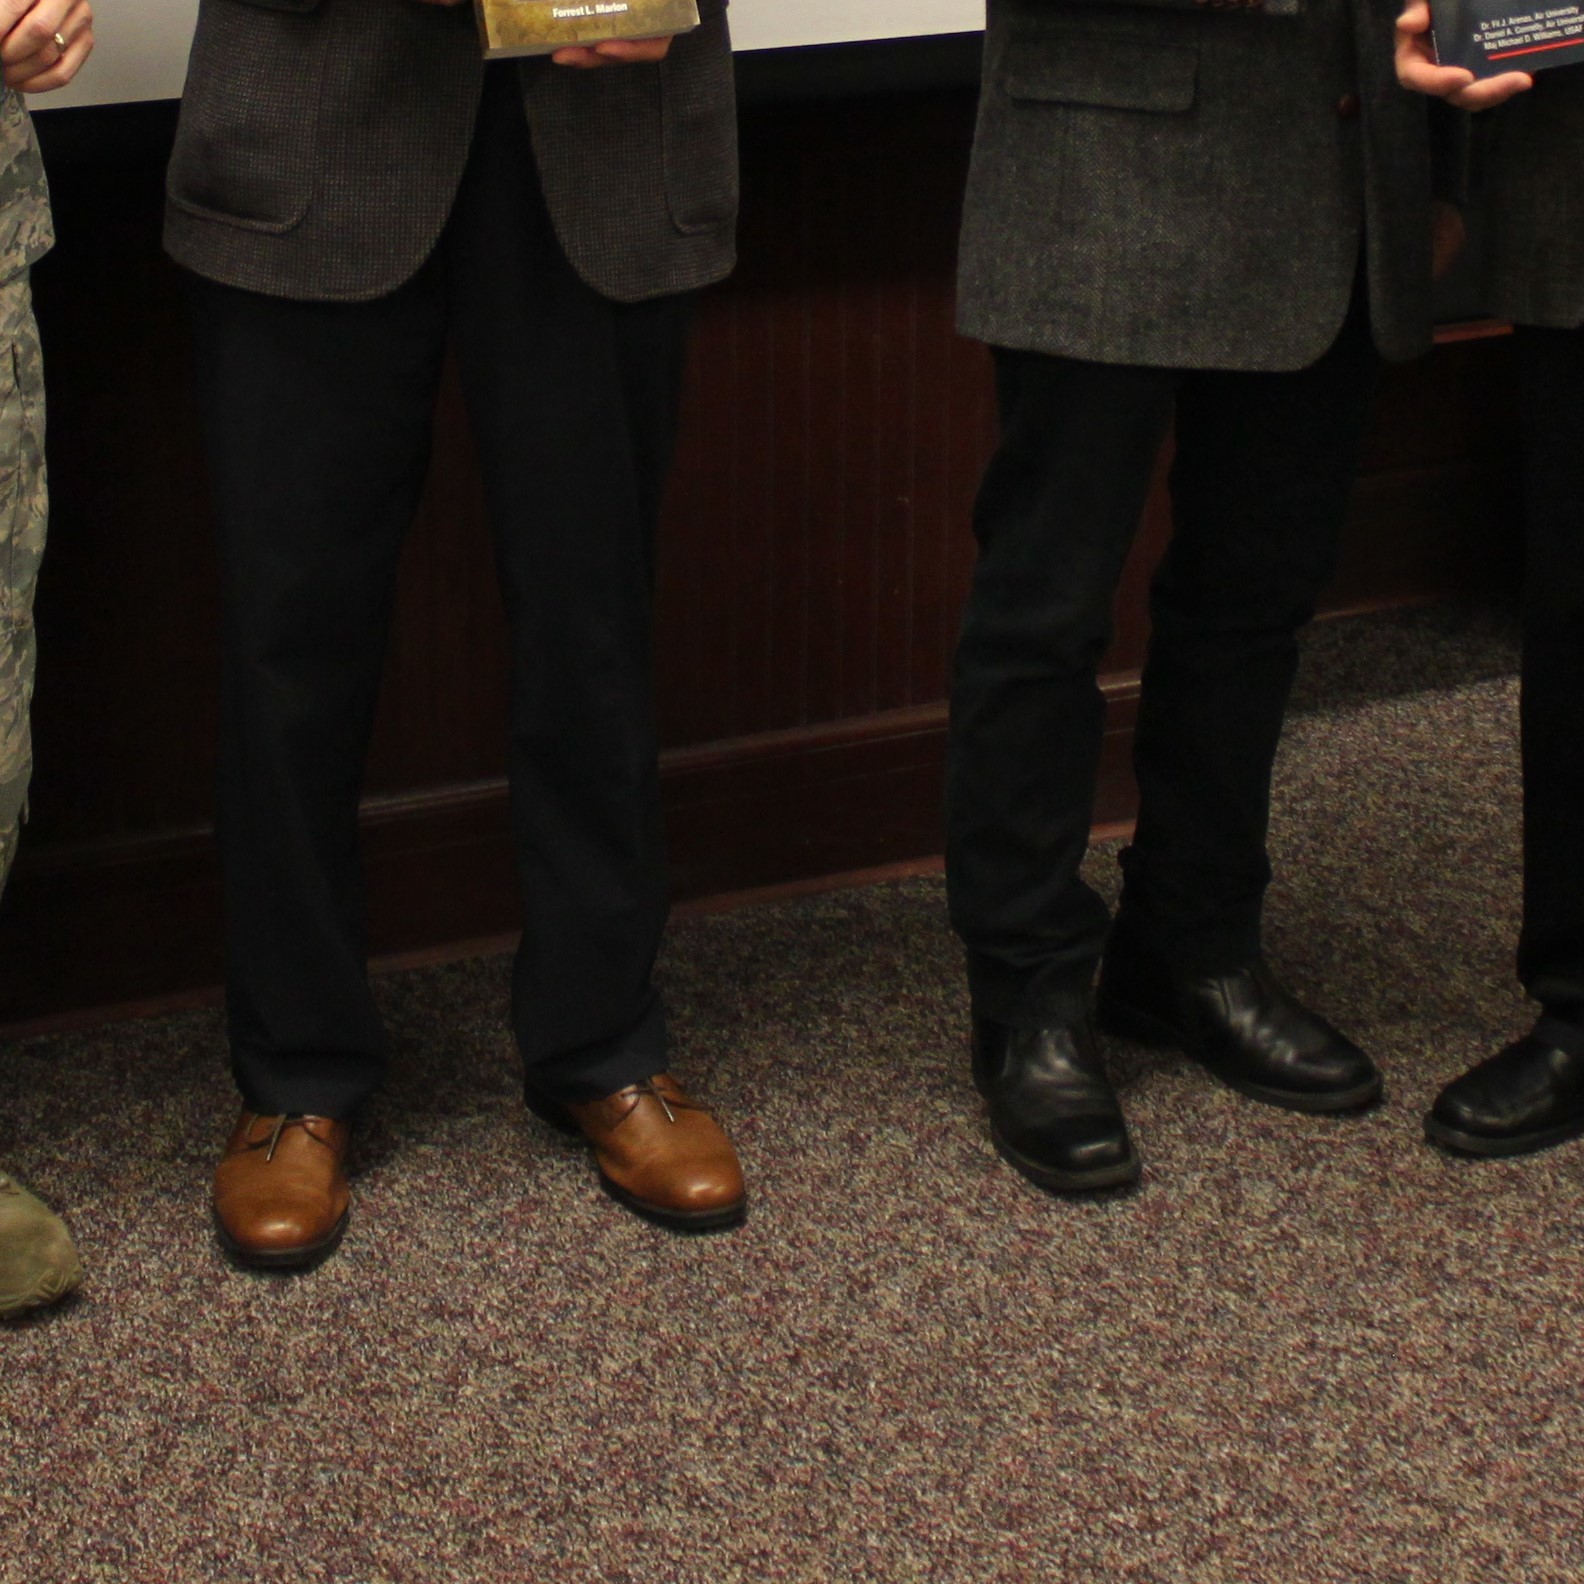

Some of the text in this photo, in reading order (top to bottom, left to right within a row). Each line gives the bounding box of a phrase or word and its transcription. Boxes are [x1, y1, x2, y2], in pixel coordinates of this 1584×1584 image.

[552, 2, 628, 18] Forrest L. Marion
